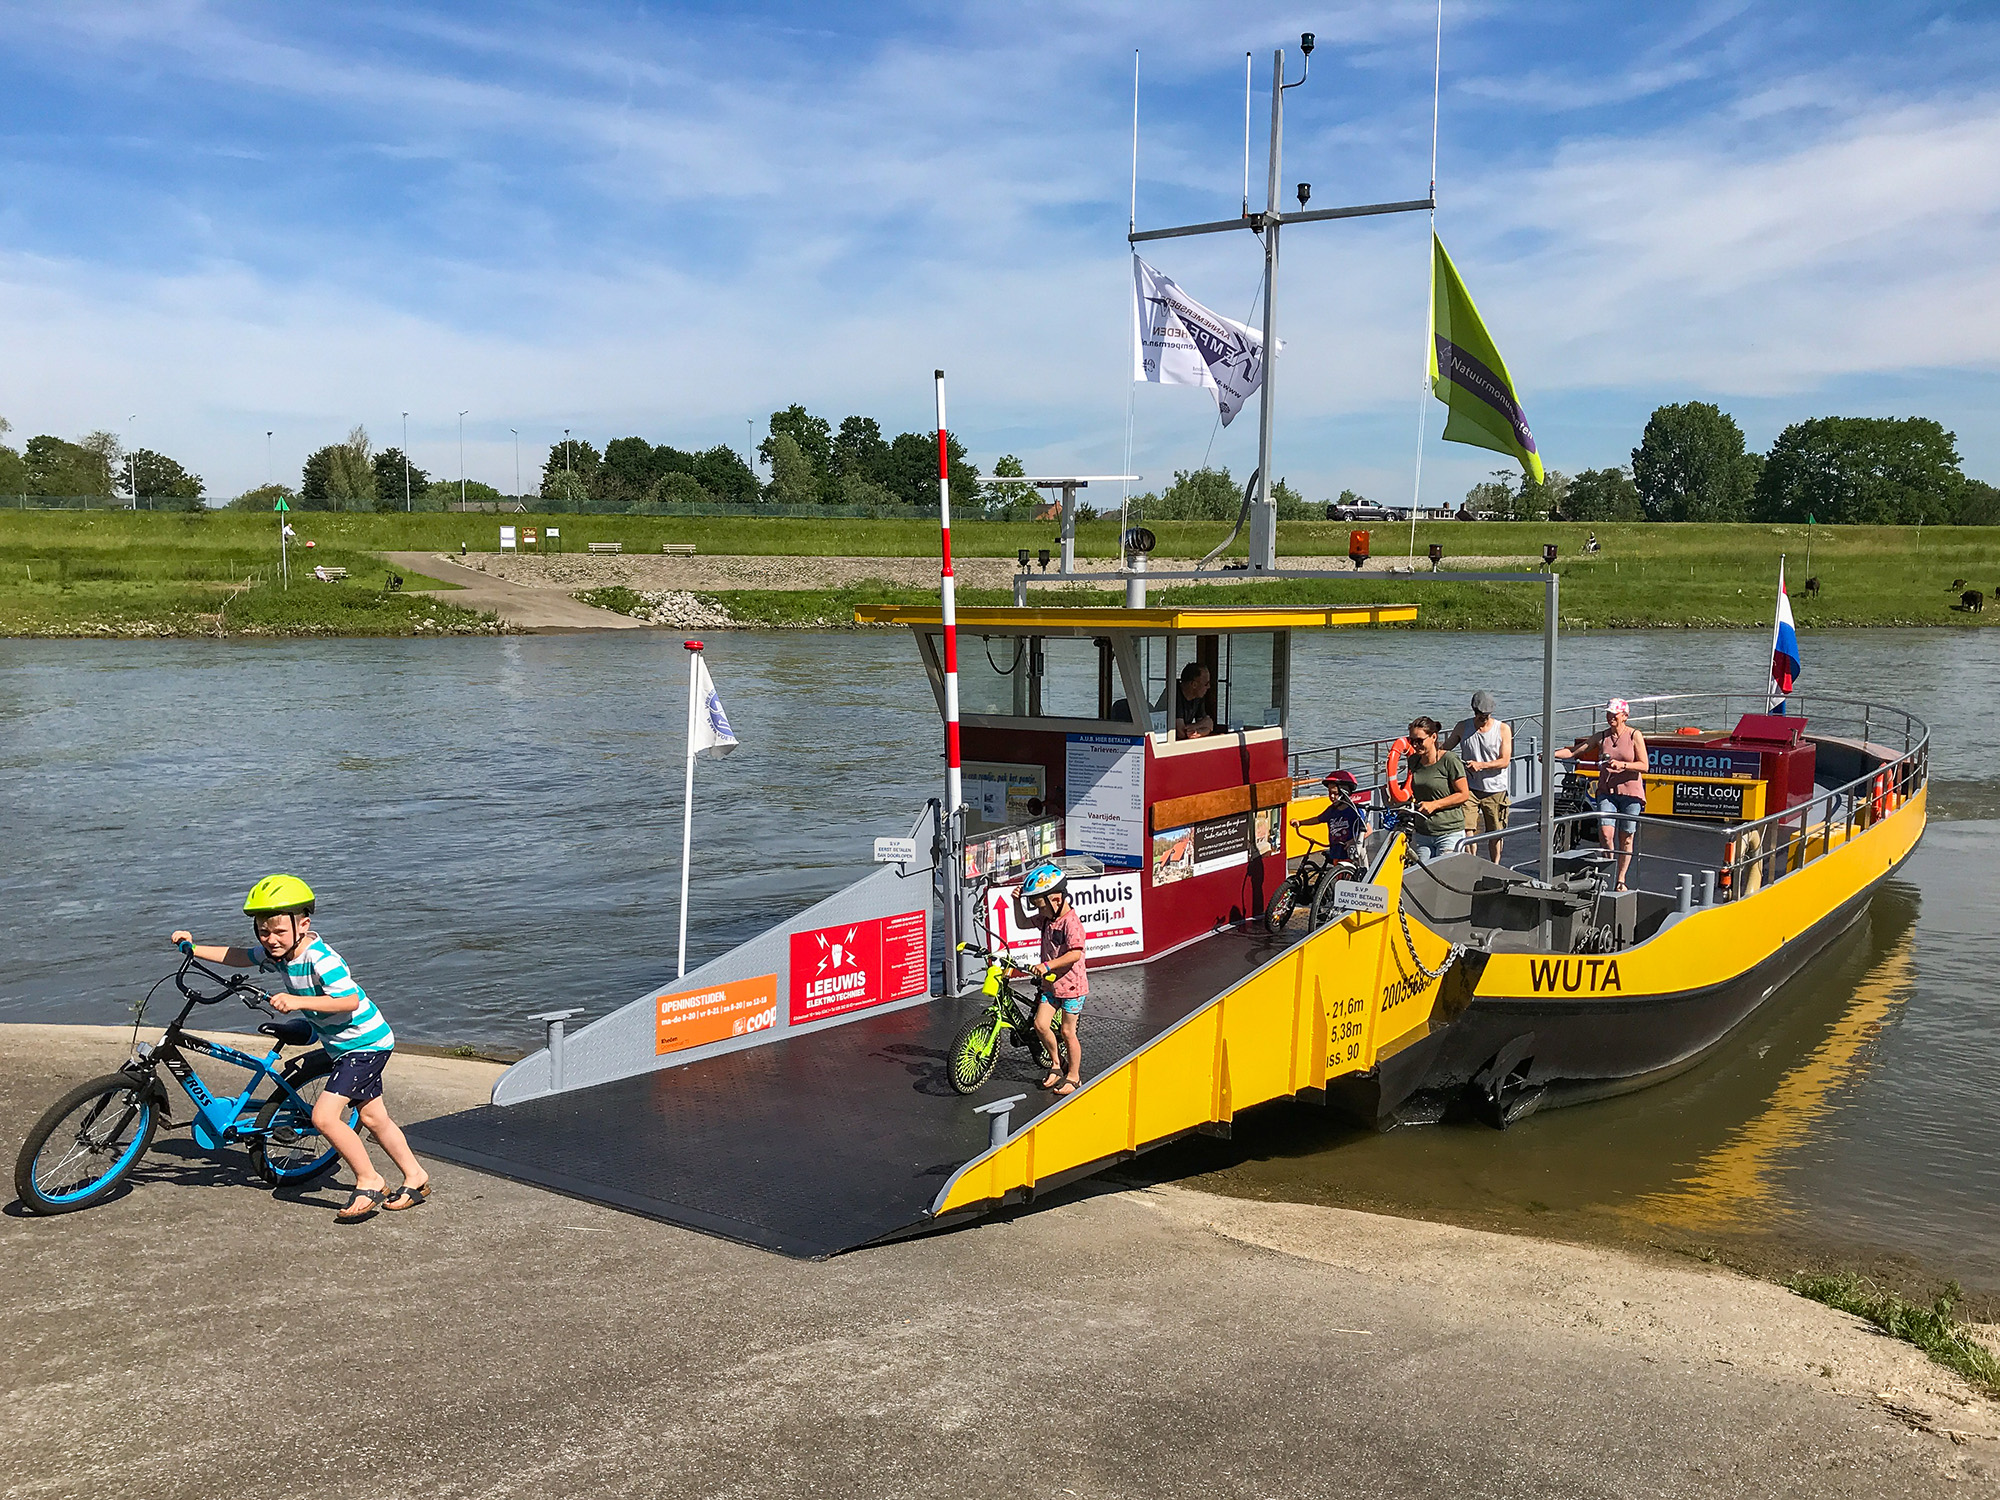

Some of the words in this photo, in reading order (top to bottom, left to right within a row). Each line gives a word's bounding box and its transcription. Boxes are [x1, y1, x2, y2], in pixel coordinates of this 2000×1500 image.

[1090, 746, 1120, 754] Tarieven:
[1676, 783, 1704, 796] First
[1709, 784, 1741, 802] Lady
[1087, 812, 1121, 822] Vaartijden
[1350, 899, 1384, 909] DOORLOPEN
[1359, 894, 1383, 902] BETALEN
[1079, 907, 1125, 924] ardij.nl
[1086, 943, 1110, 951] keringen
[1115, 938, 1140, 948] Recreatie
[806, 971, 866, 998] LEEUWIS
[1530, 959, 1622, 992] WUTA
[1332, 997, 1364, 1019] 21,6m
[661, 1015, 682, 1026] ma-do
[747, 1005, 777, 1033] coop
[1331, 1021, 1362, 1044] 5,38m
[1326, 1052, 1344, 1068] ss.
[1347, 1043, 1359, 1061] 90
